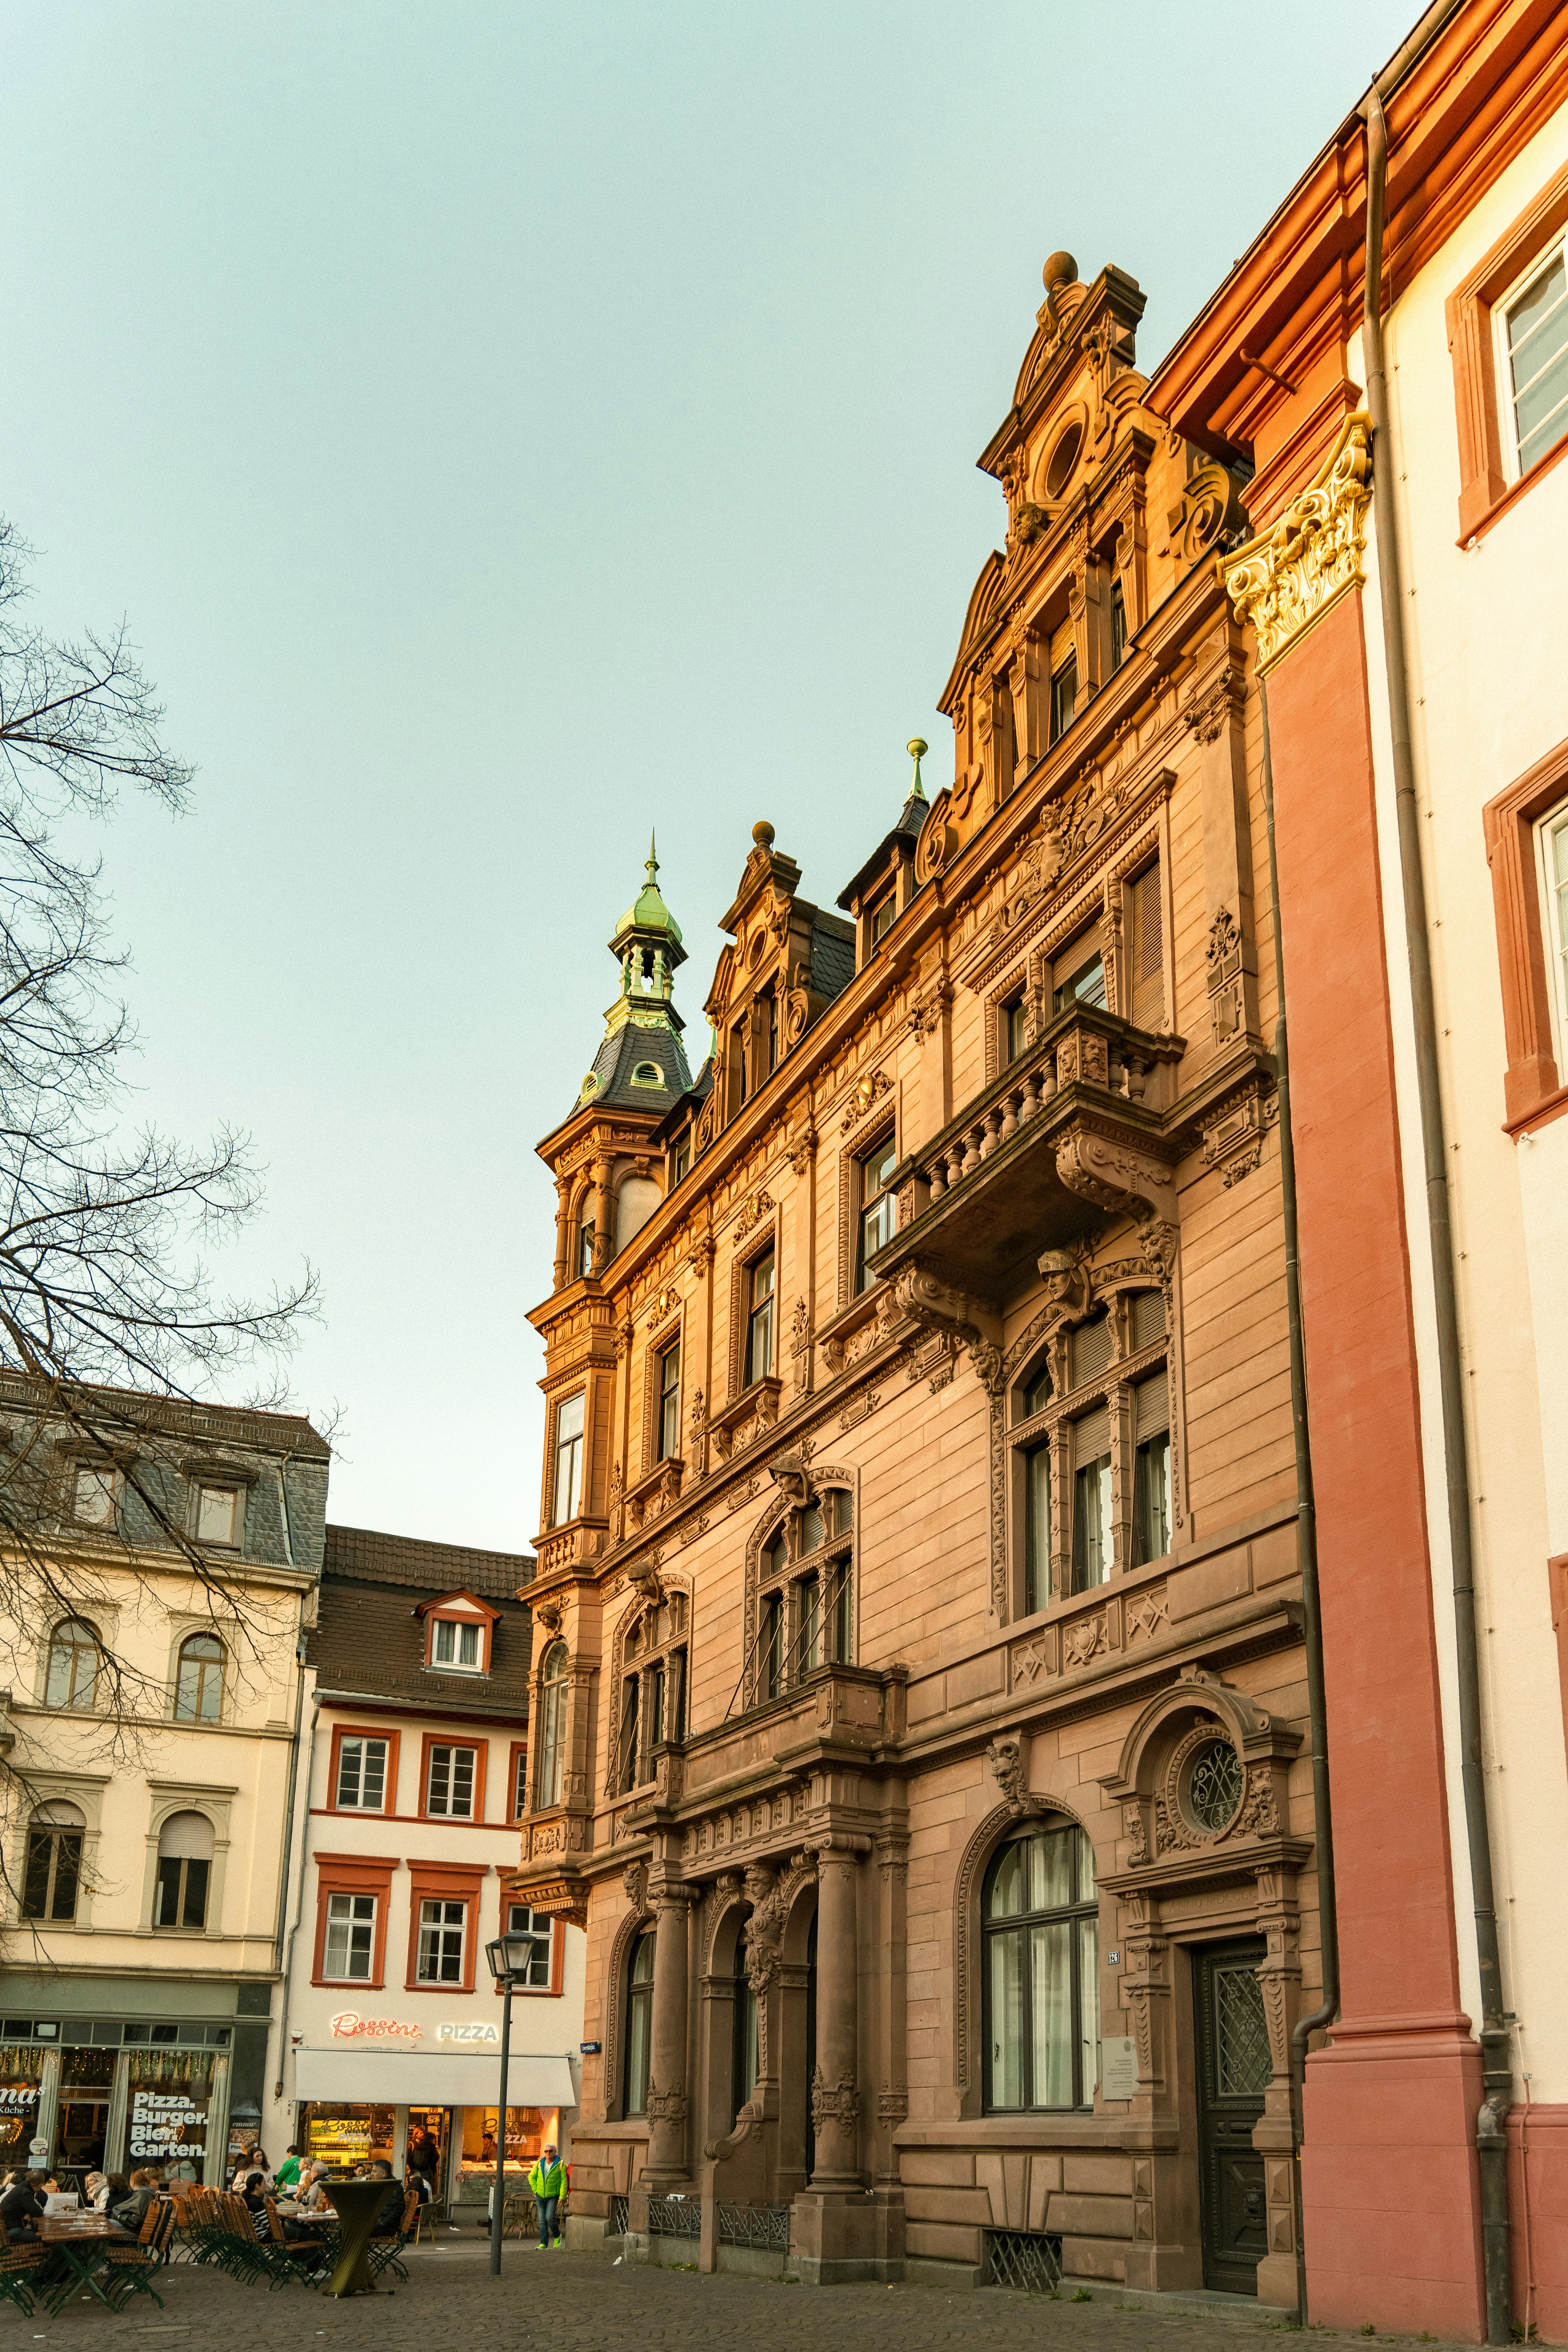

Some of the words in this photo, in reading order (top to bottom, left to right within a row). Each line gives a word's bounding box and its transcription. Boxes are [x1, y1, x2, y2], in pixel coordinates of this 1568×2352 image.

[1109, 1953, 1117, 1962] 126
[332, 2013, 422, 2038] Rossini
[441, 2024, 497, 2040] PIZZA
[134, 2092, 195, 2108] Pizza.
[132, 2108, 209, 2127] Burger.
[322, 2117, 385, 2134] Rossini
[131, 2125, 177, 2141] Bier.
[338, 2132, 373, 2142] PIZZA
[495, 2135, 528, 2144] ZZA
[130, 2141, 207, 2157] Garten.
